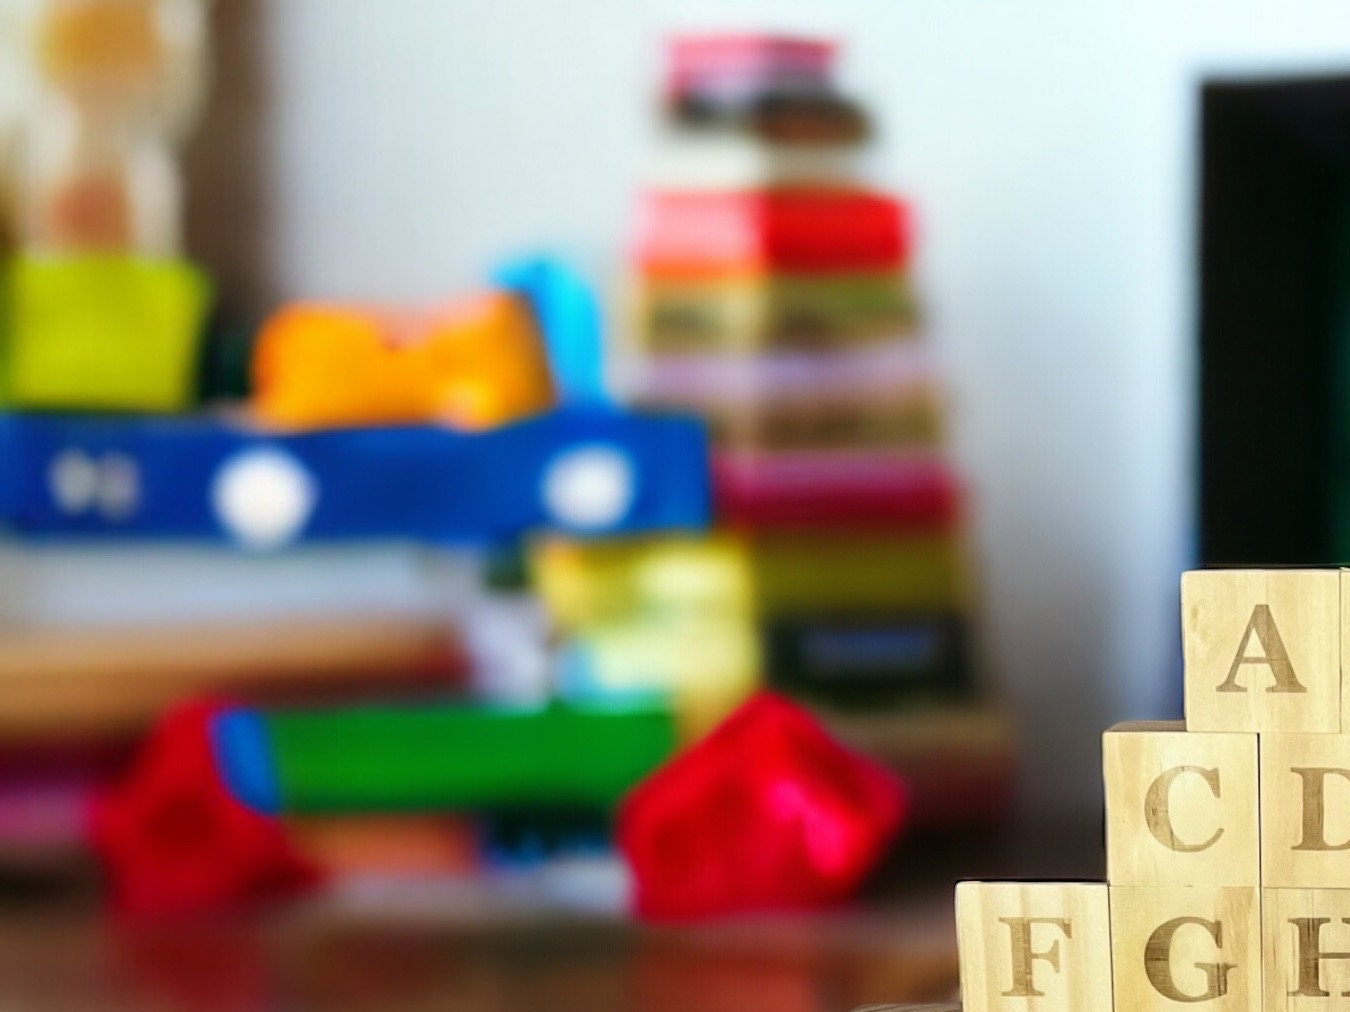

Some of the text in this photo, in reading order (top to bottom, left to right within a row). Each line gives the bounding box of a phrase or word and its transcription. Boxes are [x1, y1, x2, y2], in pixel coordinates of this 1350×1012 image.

[1216, 604, 1306, 693] A
[1144, 765, 1225, 853] C
[999, 917, 1073, 997] F
[1143, 916, 1238, 1003] G
